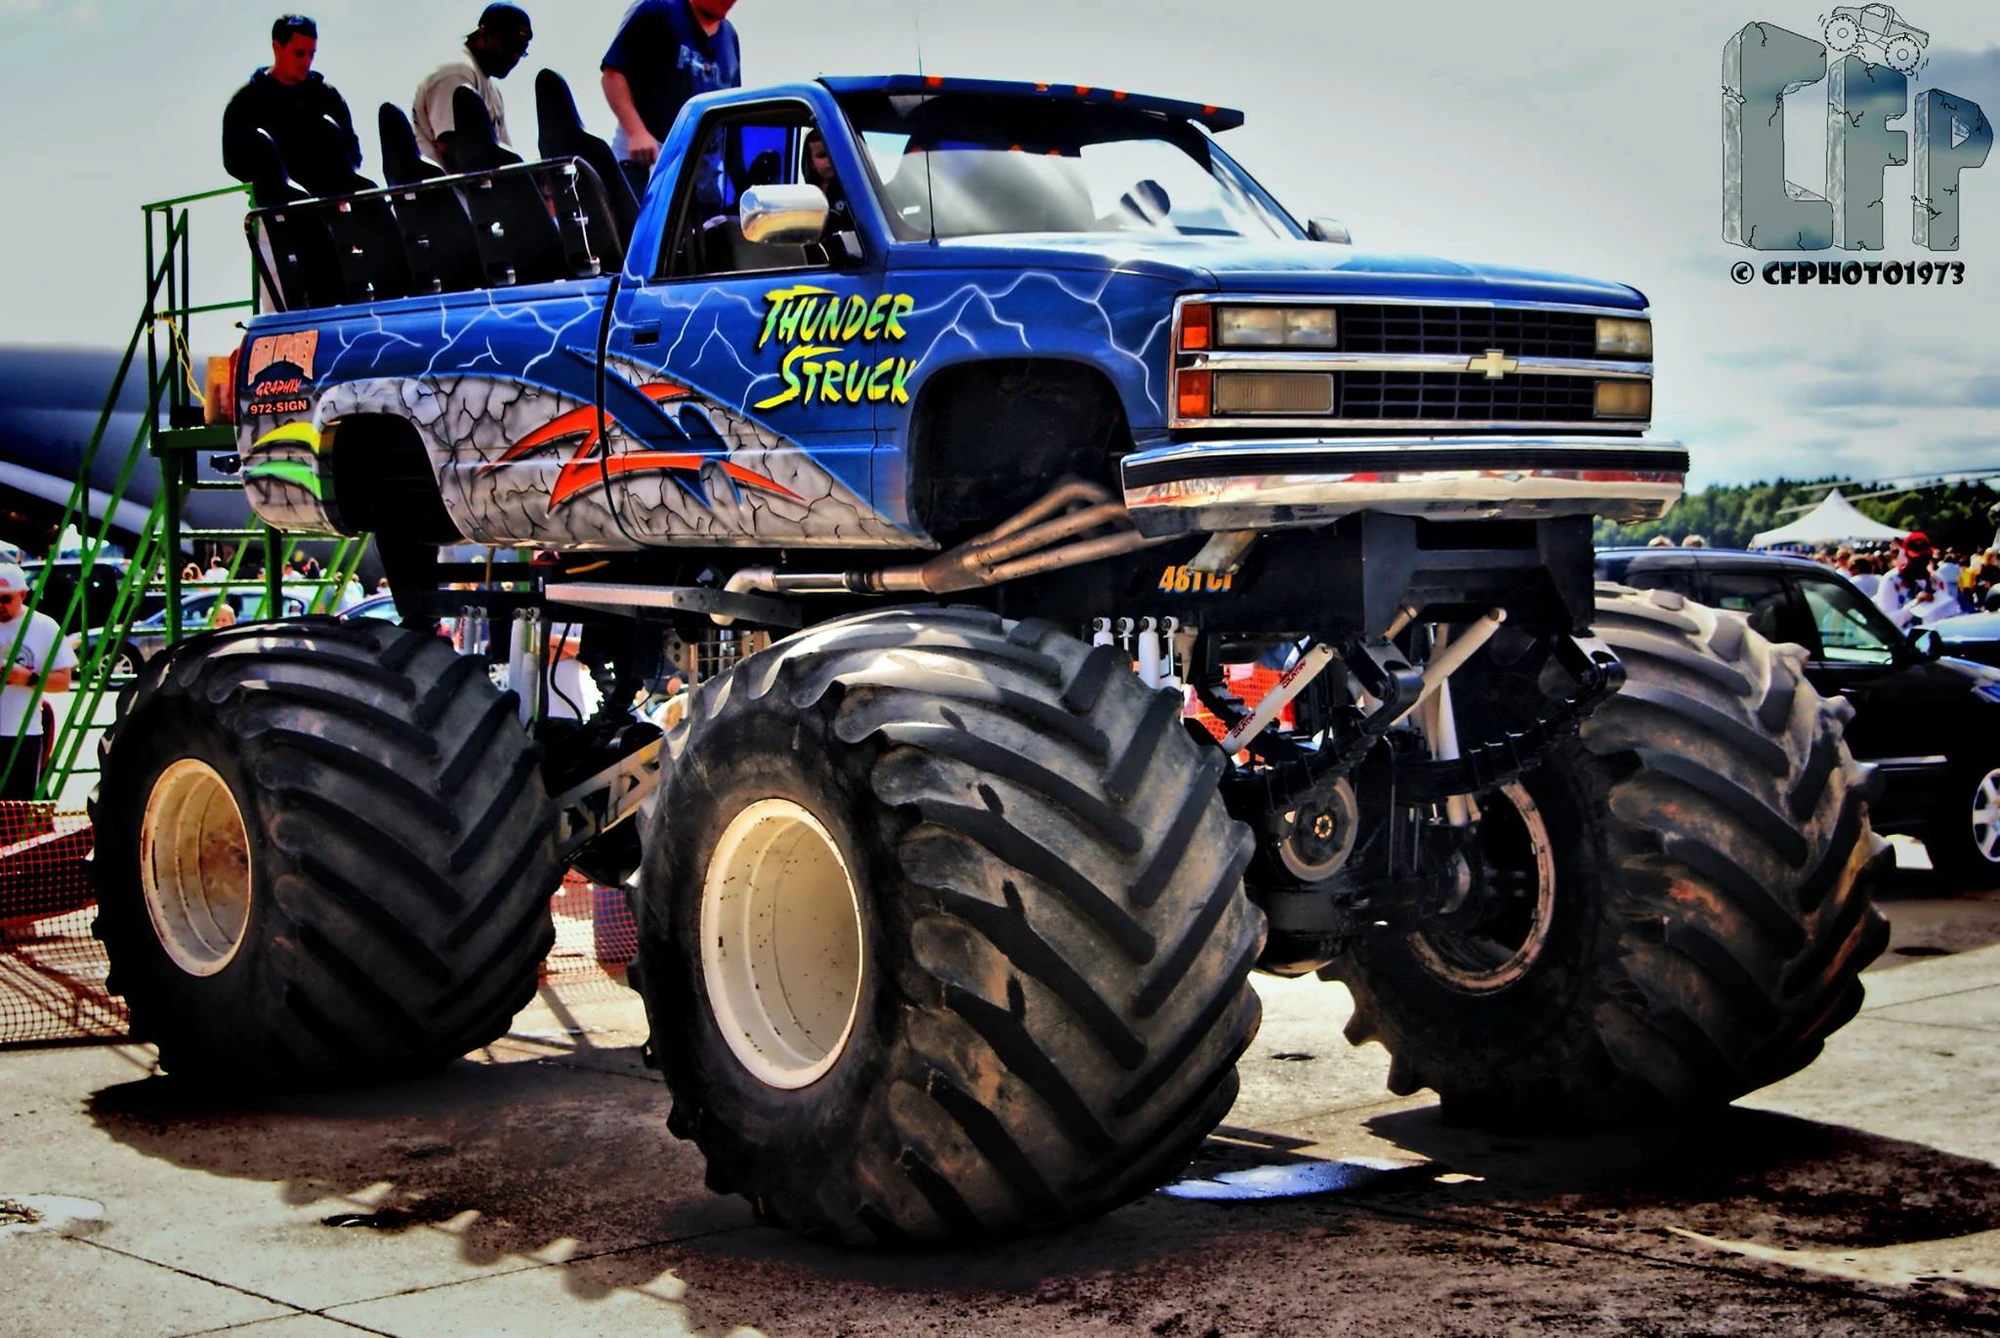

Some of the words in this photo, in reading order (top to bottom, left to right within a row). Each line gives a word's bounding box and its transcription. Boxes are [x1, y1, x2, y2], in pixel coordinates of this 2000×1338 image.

[758, 284, 915, 349] THUNDER
[250, 400, 308, 415] 972-SIGN
[753, 344, 917, 409] STRUCK
